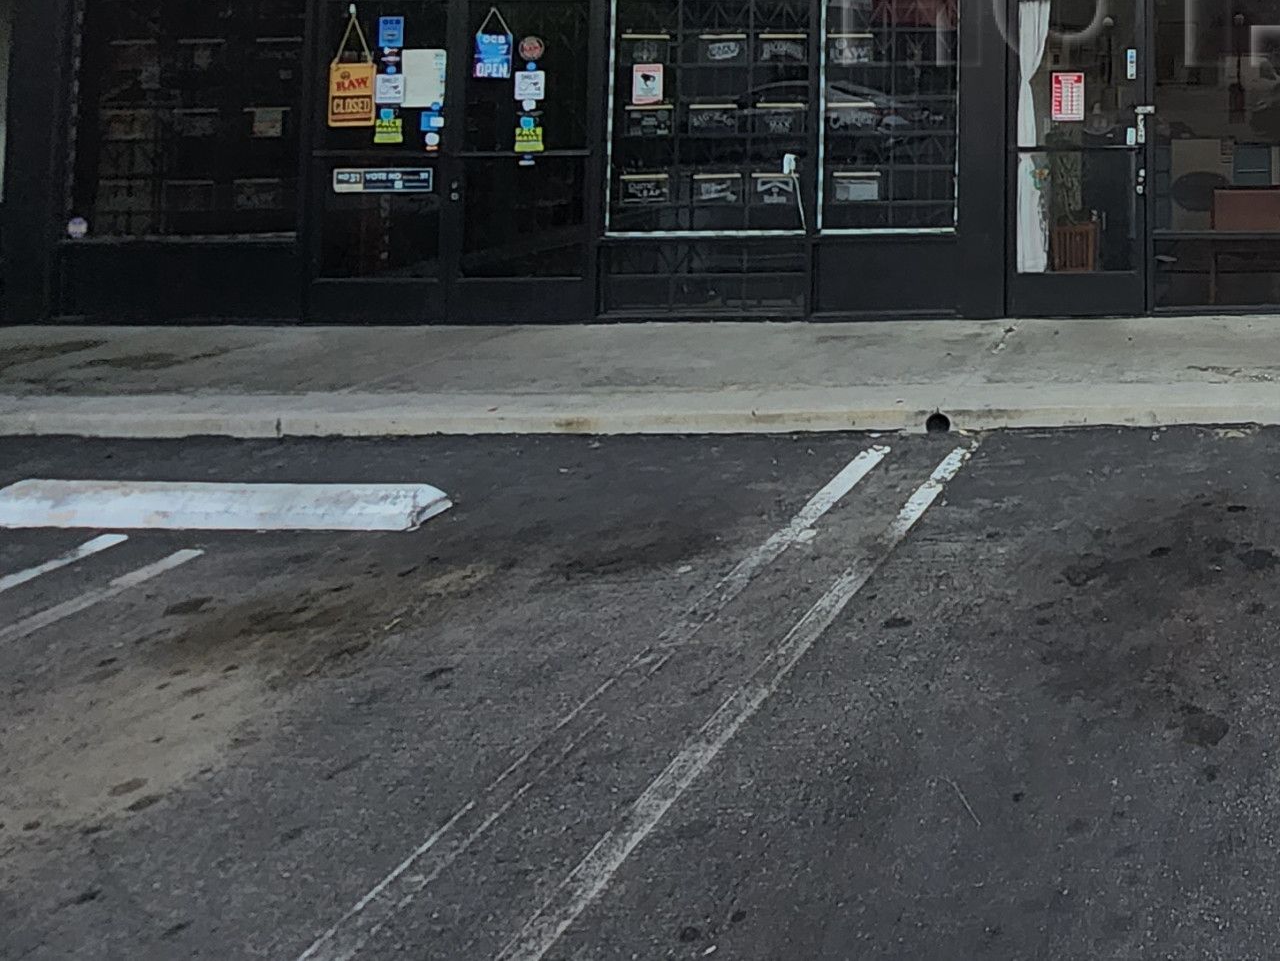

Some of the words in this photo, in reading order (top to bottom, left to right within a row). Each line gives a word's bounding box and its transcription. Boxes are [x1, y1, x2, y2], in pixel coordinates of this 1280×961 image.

[475, 62, 508, 78] OPEN
[335, 76, 370, 92] RAW
[332, 98, 371, 114] CLOSED
